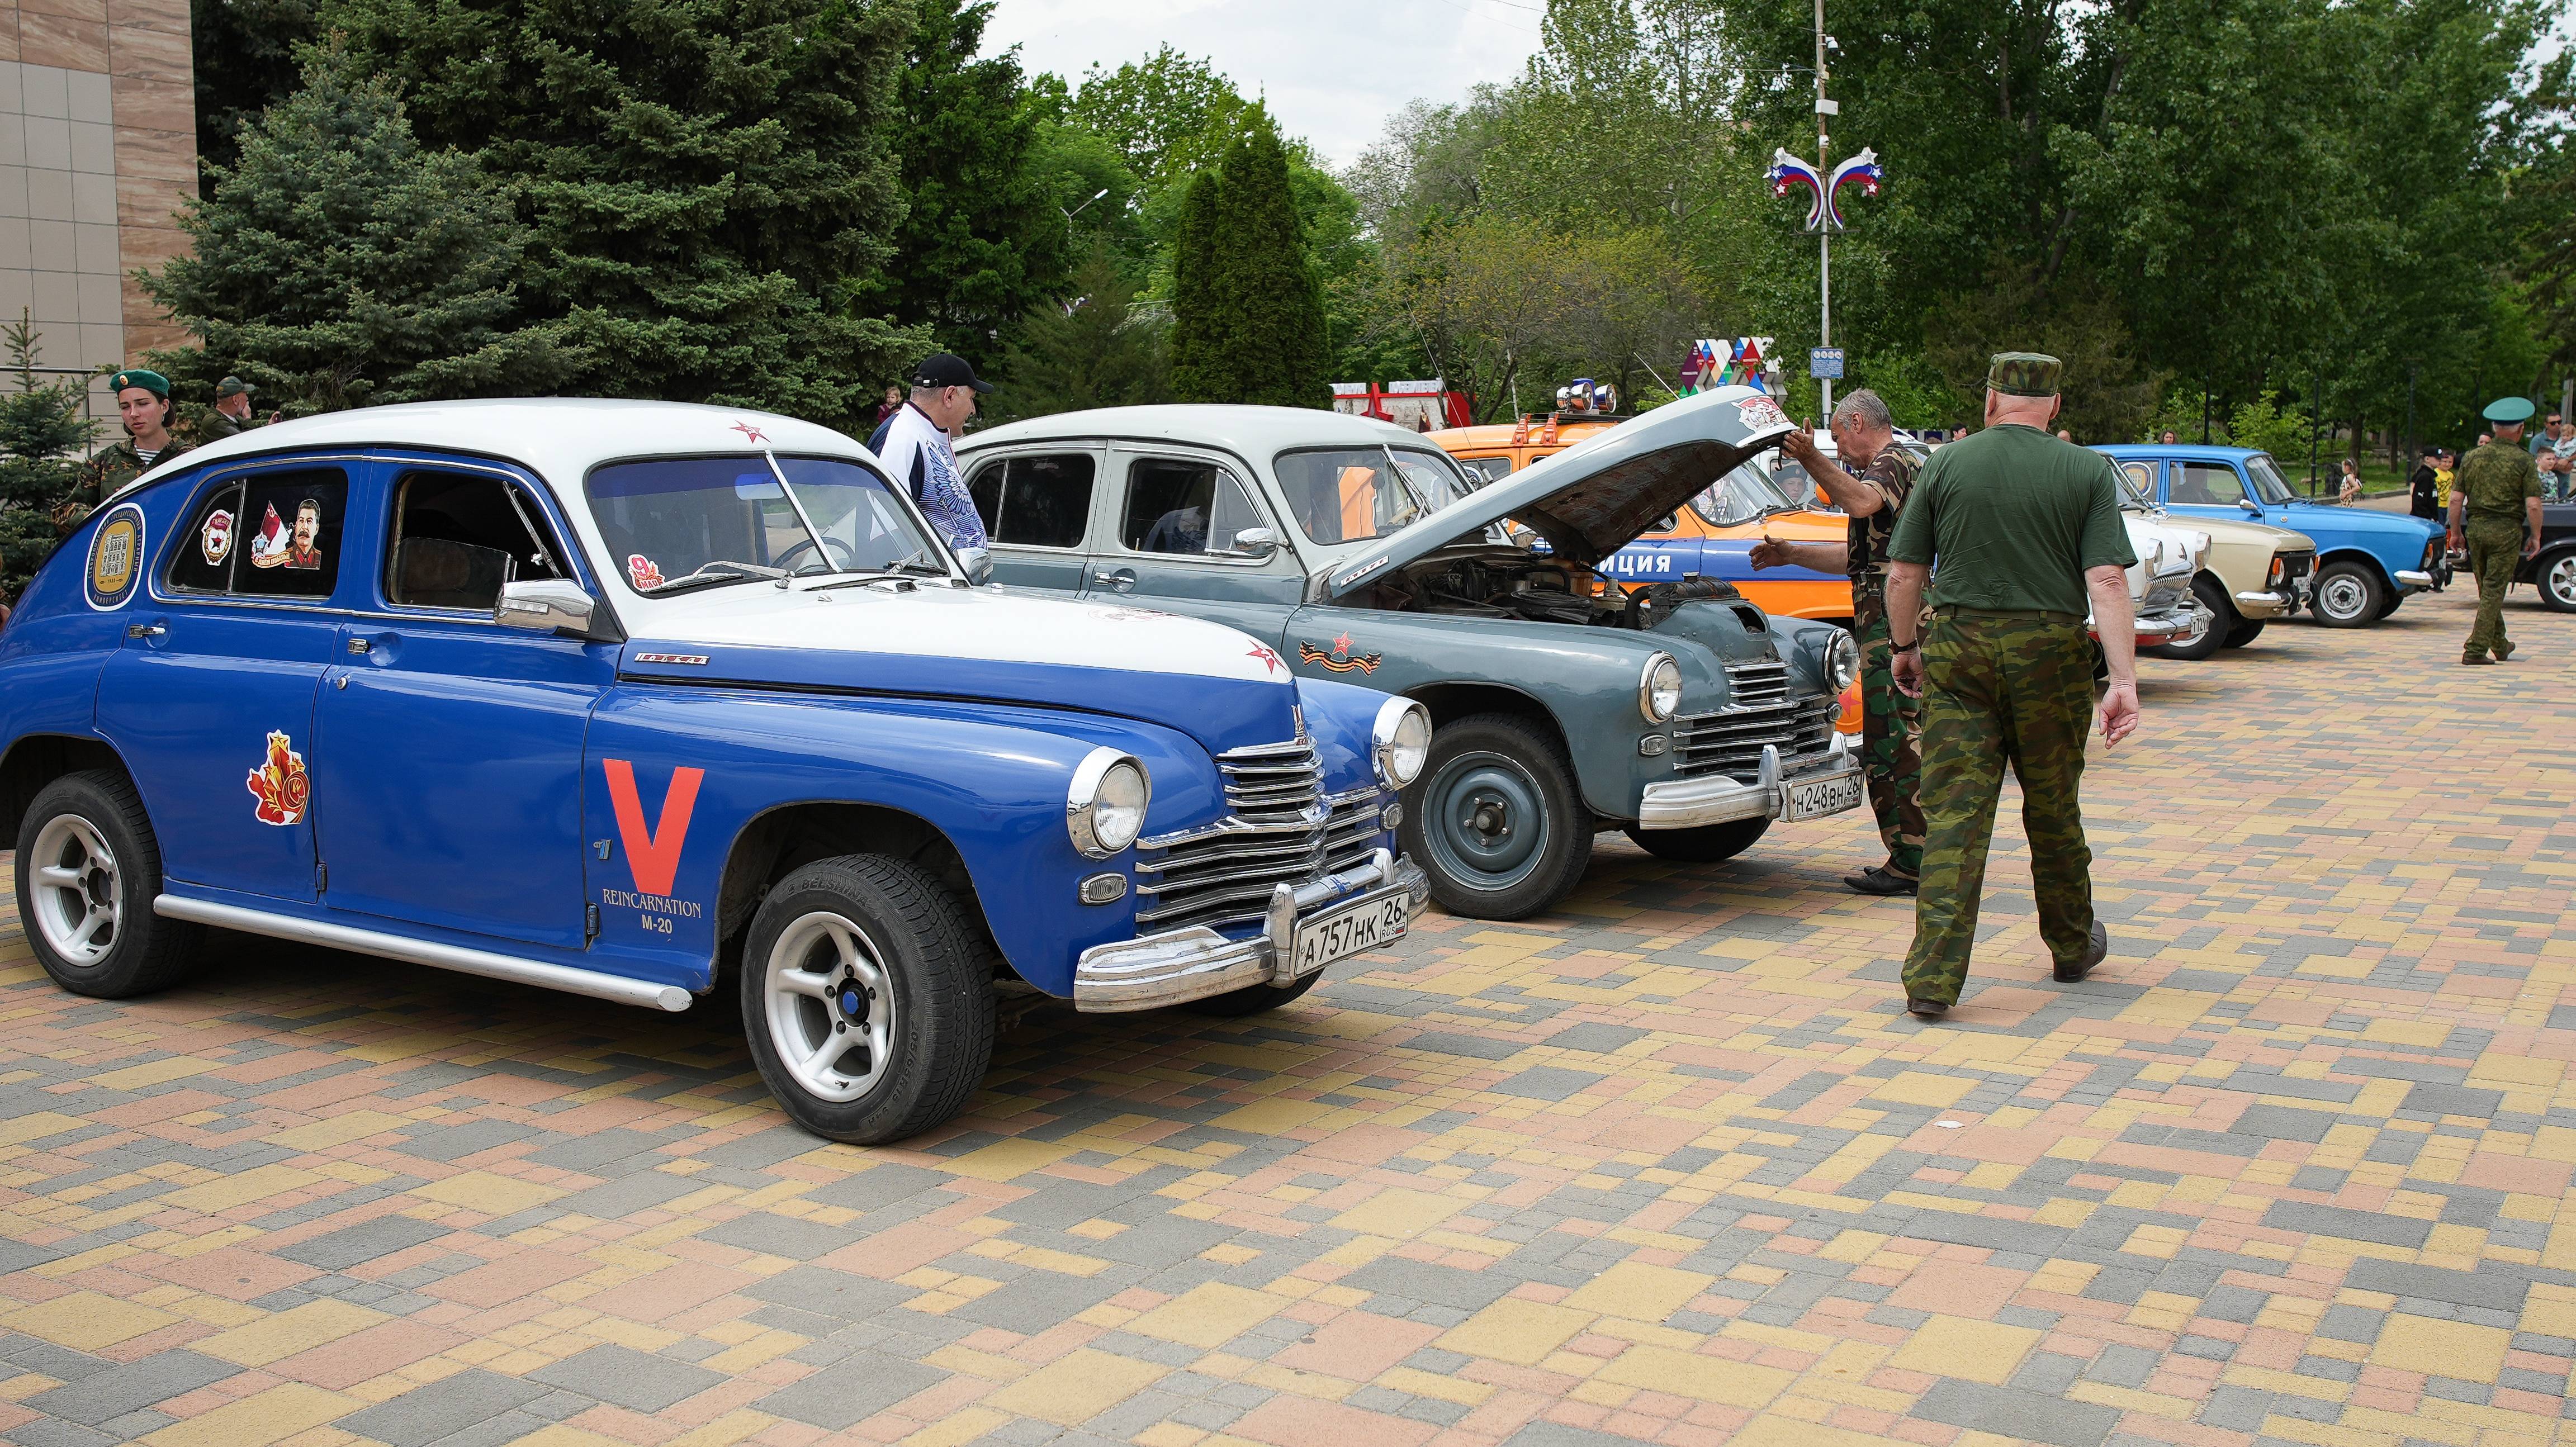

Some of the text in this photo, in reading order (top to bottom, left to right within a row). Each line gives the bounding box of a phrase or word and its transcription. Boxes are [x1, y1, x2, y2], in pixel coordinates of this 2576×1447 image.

[133, 534, 142, 572] АГРАРНЫЙ
[632, 557, 650, 576] 9
[93, 589, 129, 604] УНИВЕРСИТЕТ
[1797, 776, 1858, 814] Н248ВН 26
[603, 758, 705, 896] V
[603, 889, 701, 918] REINCARNATION
[642, 914, 673, 934] M-20
[1304, 898, 1401, 967] А757НК 26
[1381, 927, 1395, 938] RUS
